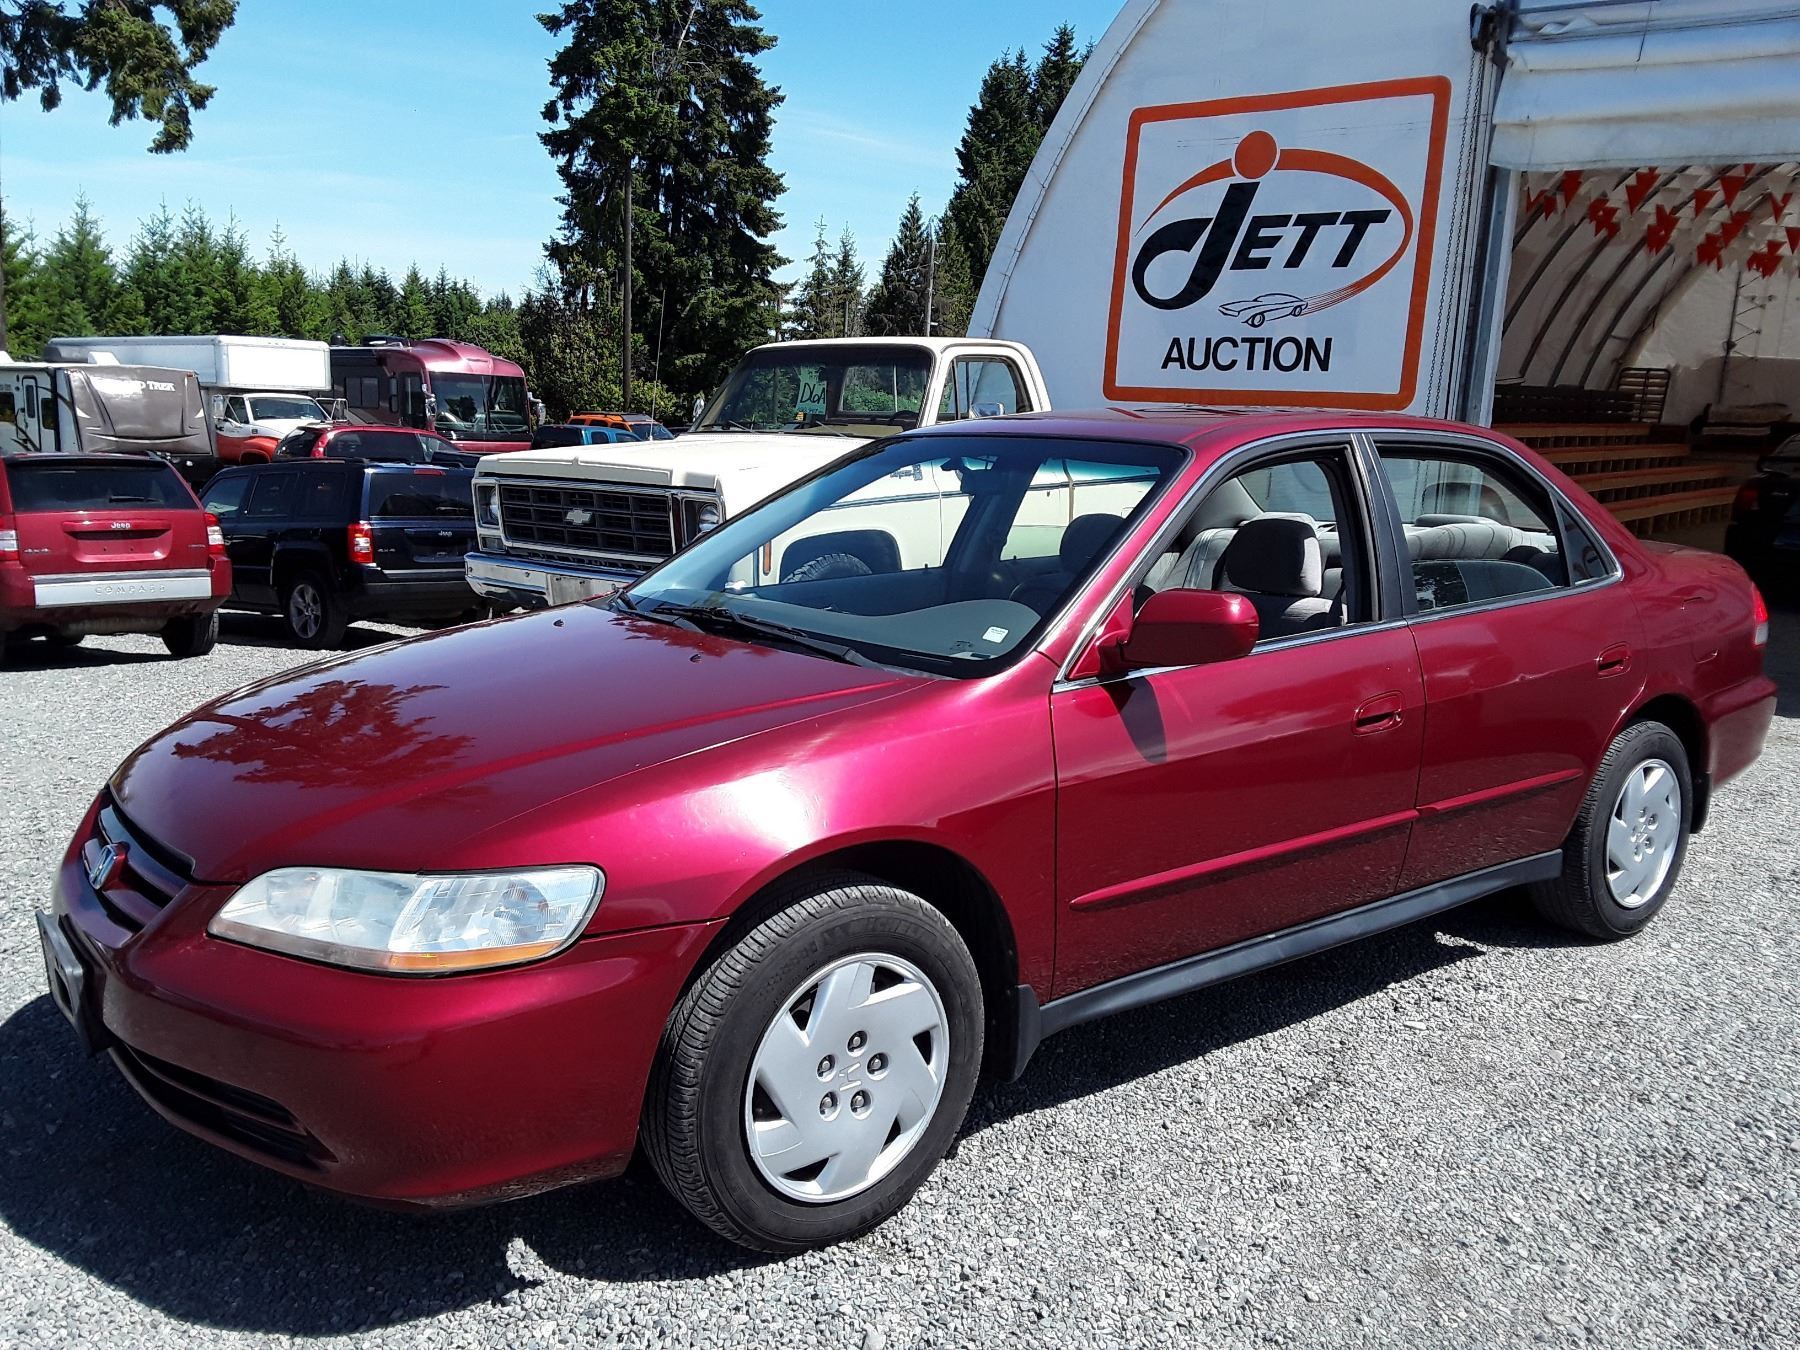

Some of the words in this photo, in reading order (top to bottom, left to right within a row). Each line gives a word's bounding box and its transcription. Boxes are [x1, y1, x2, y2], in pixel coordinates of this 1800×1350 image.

[1161, 336, 1333, 372] AUCTION
[147, 380, 176, 391] TREK
[95, 584, 166, 595] COMPASS
